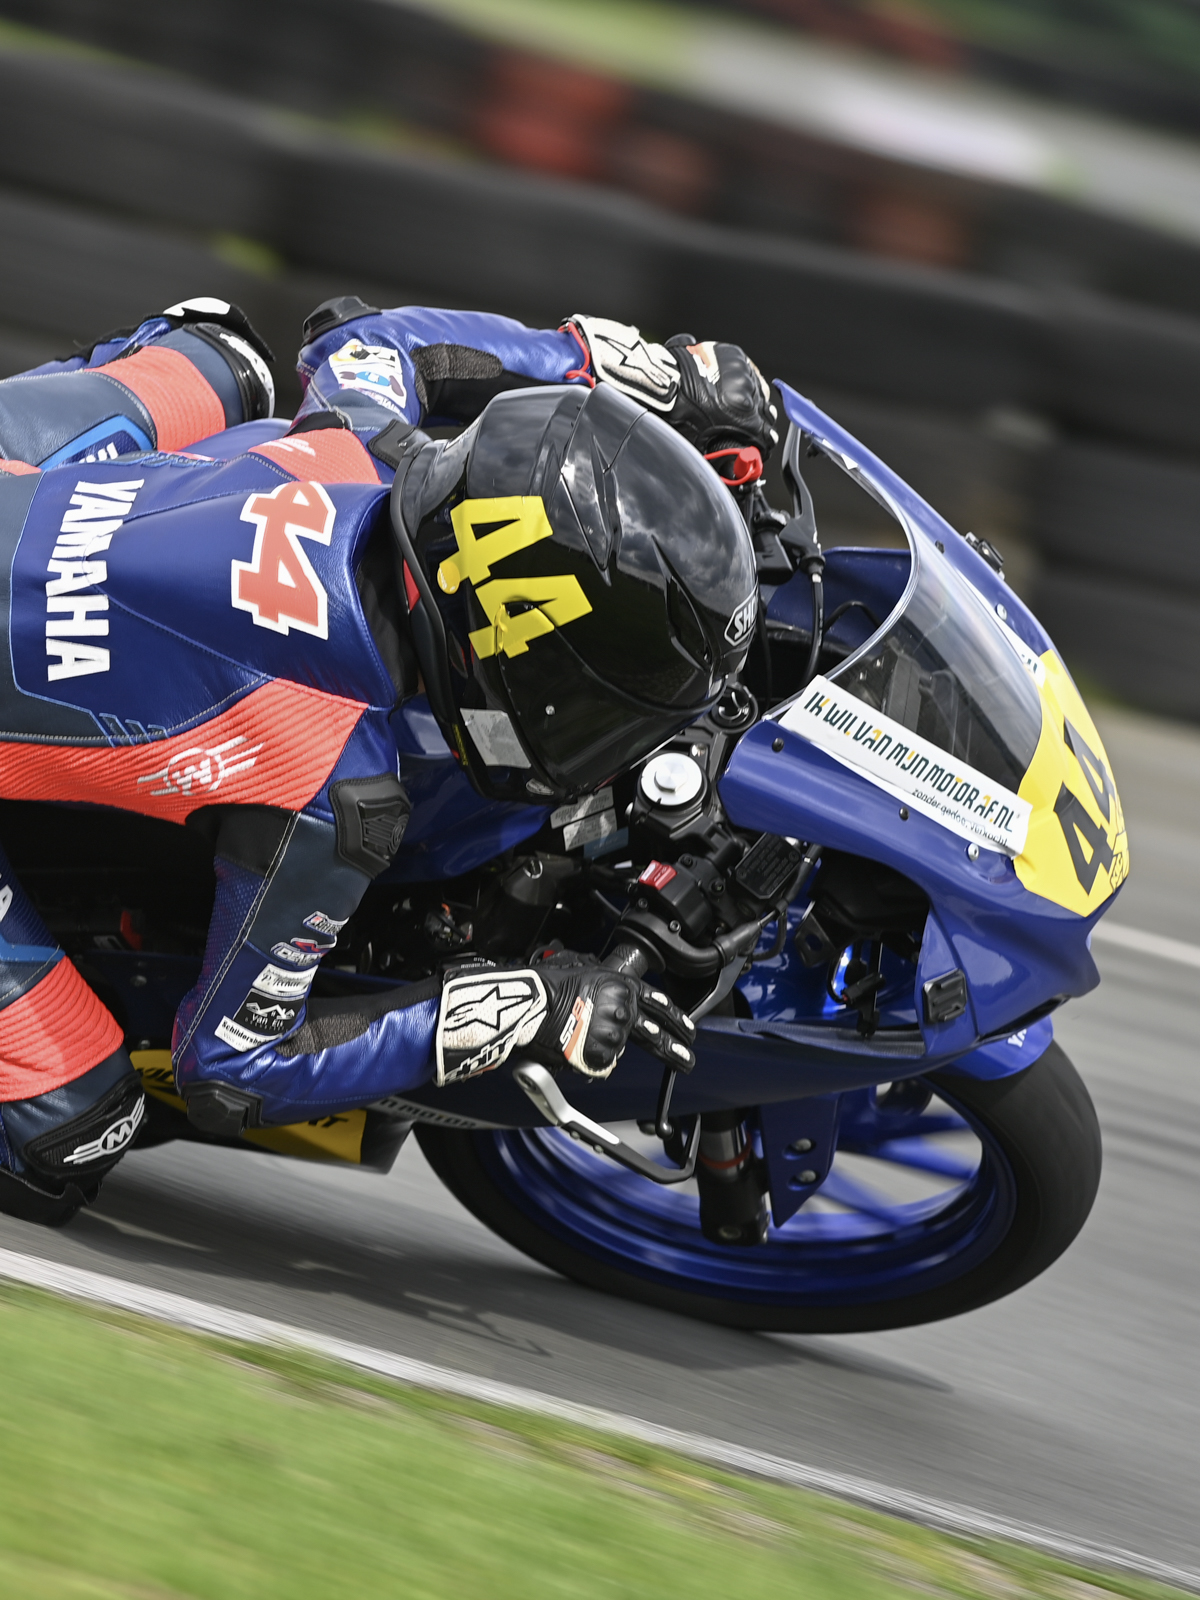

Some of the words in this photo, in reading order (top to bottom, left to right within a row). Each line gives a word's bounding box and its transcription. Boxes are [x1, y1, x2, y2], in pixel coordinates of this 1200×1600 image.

[45, 478, 145, 682] YAMAHA
[231, 481, 337, 641] 44
[438, 495, 593, 660] 44
[1053, 715, 1115, 897] 44
